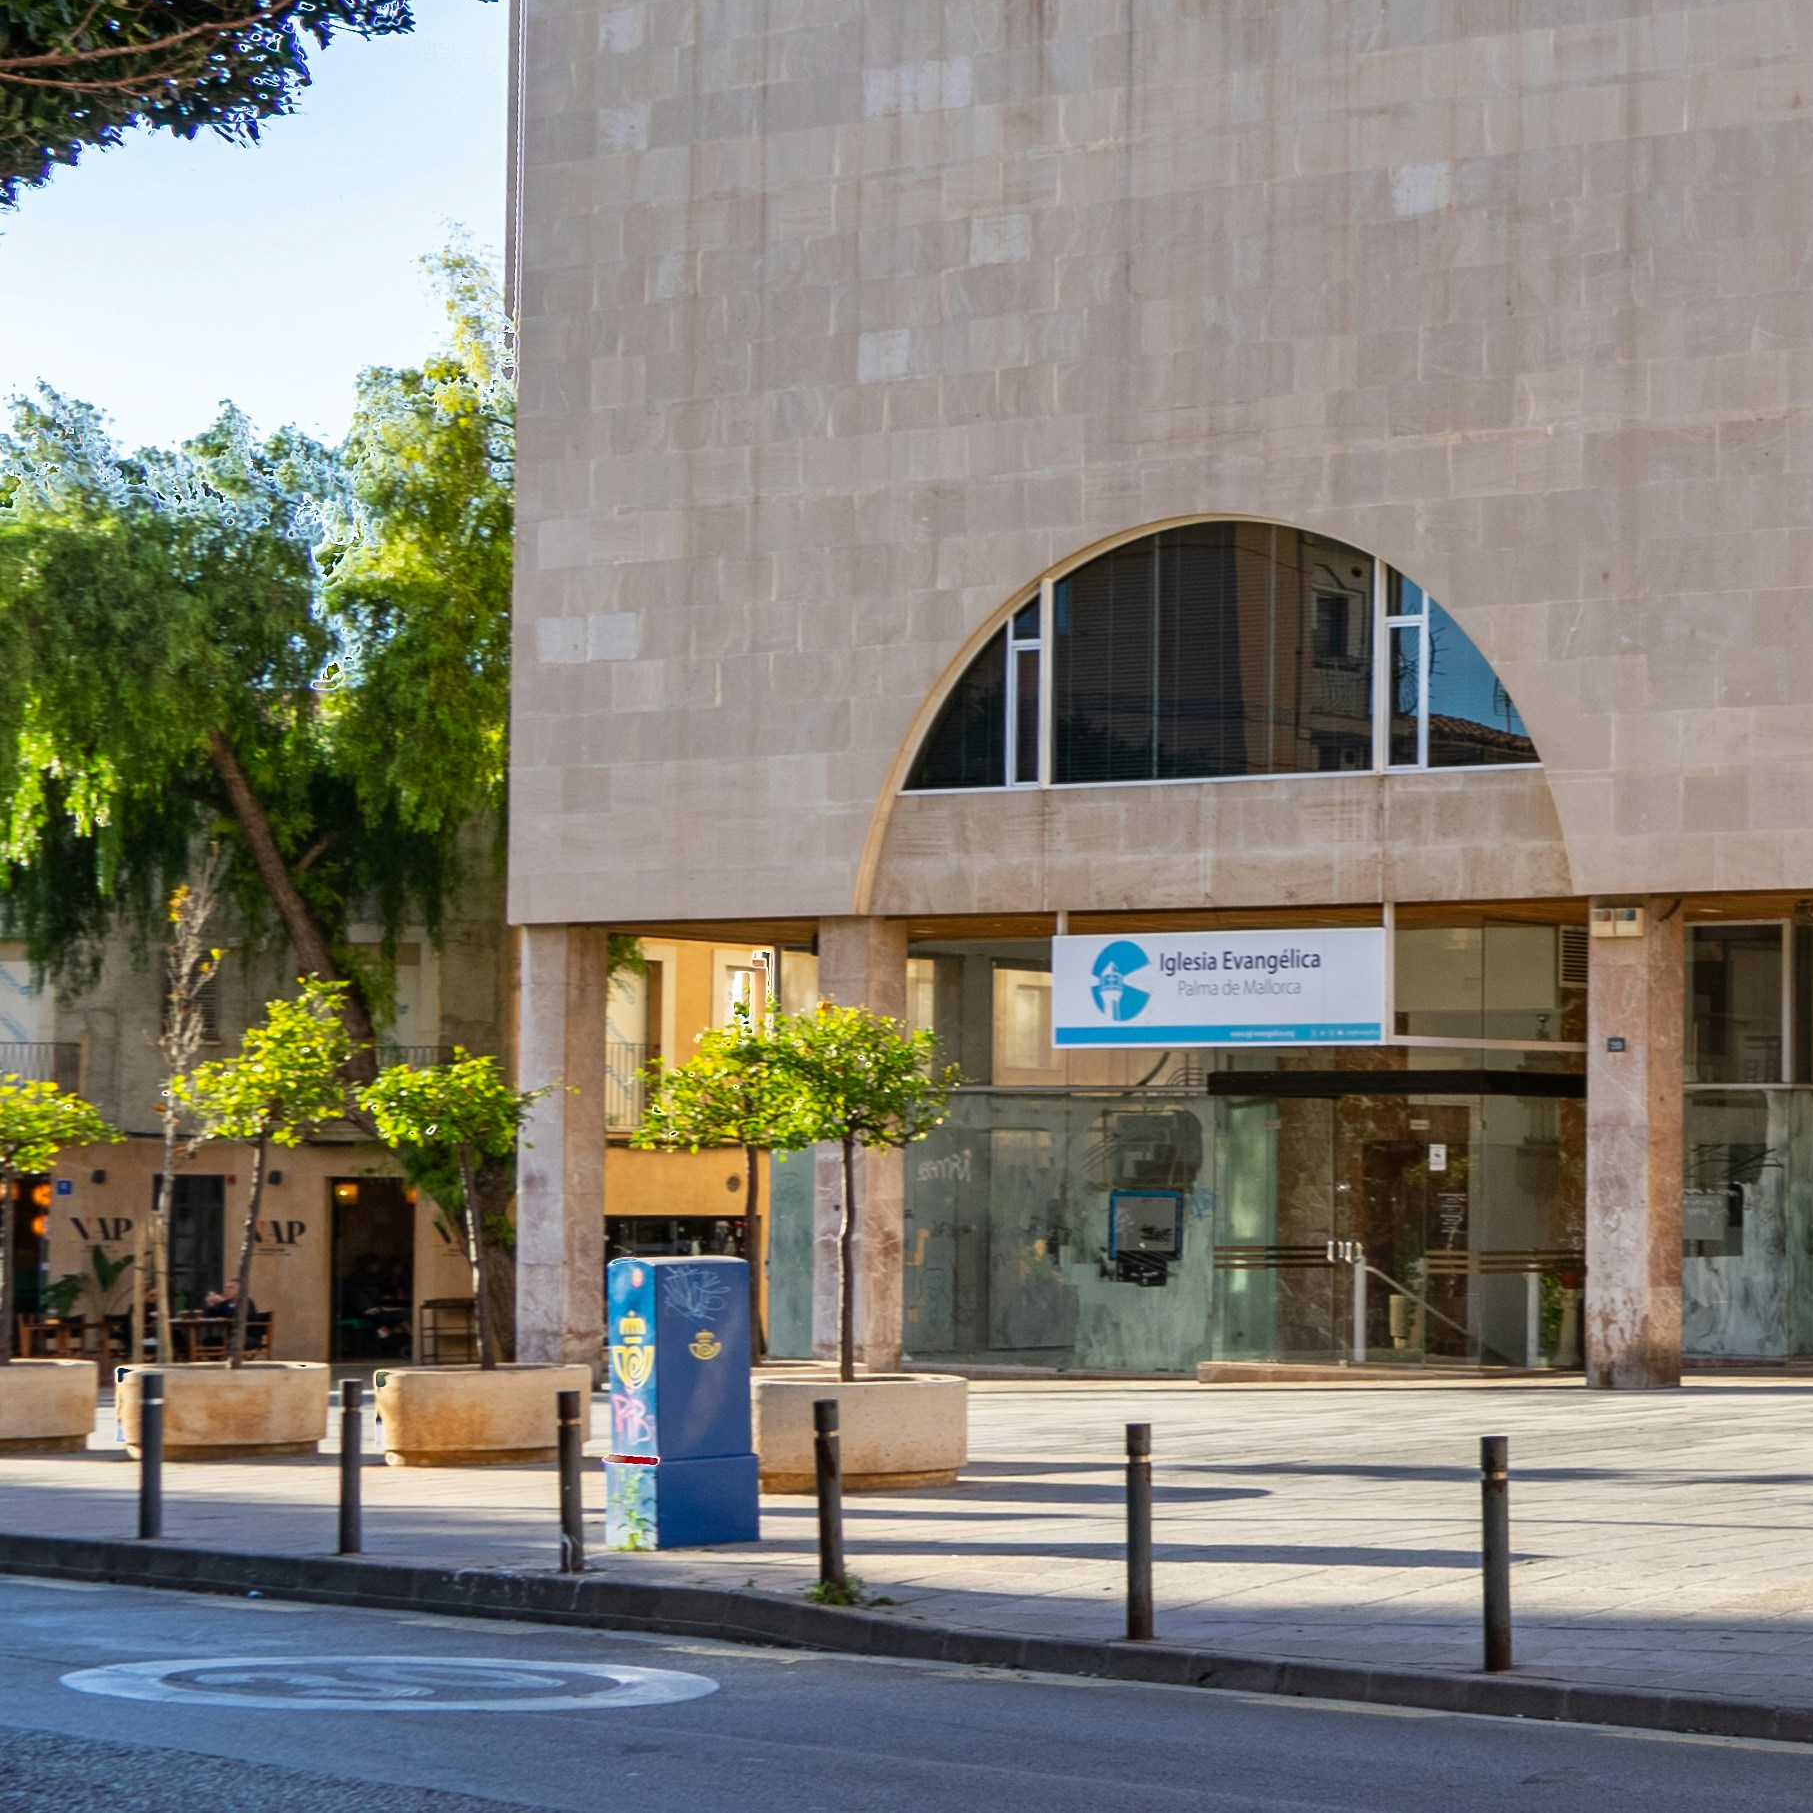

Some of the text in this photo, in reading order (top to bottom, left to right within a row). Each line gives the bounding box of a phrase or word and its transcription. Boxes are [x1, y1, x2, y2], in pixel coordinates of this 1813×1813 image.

[1160, 949, 1321, 977] Iglesia Evangélica
[1177, 979, 1302, 997] Palma de Mallorca
